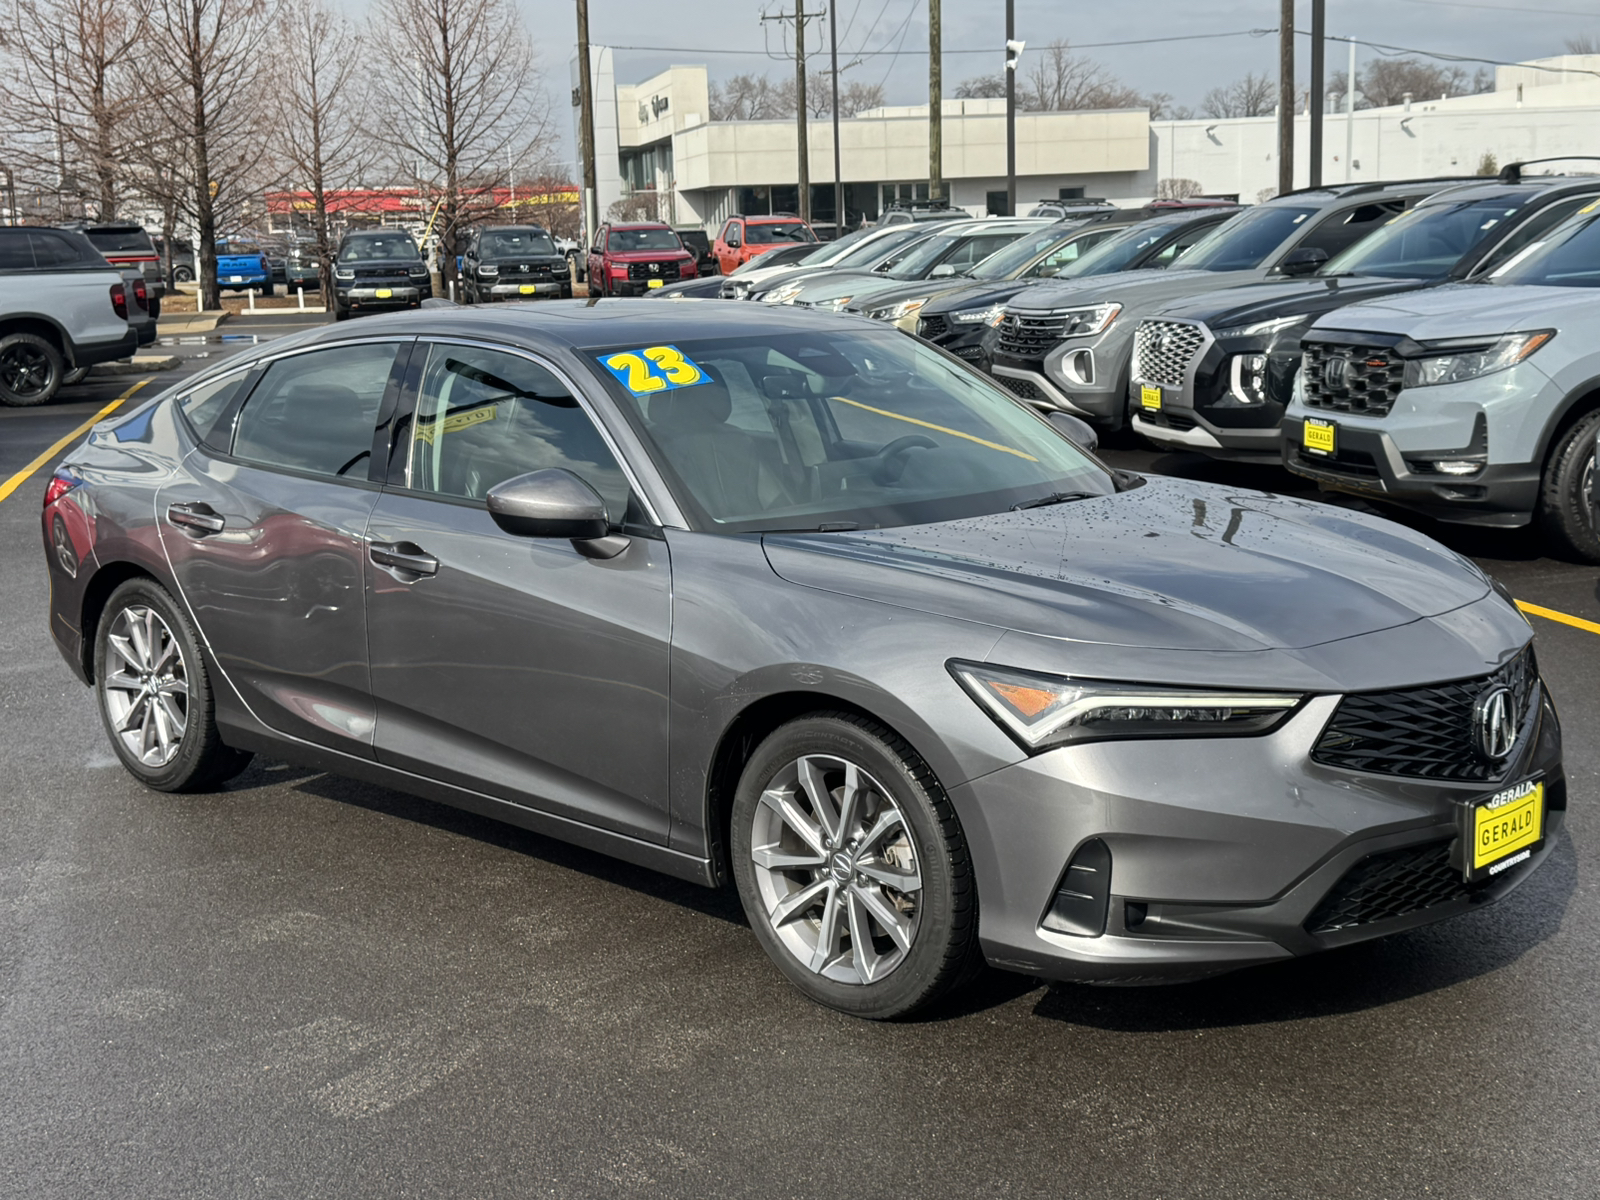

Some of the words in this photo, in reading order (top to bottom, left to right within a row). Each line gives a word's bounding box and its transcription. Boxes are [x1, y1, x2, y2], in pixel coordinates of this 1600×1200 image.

[606, 346, 701, 392] 23
[1308, 431, 1331, 442] GERALD
[1491, 780, 1533, 808] GERALD
[1481, 810, 1532, 846] GERALD
